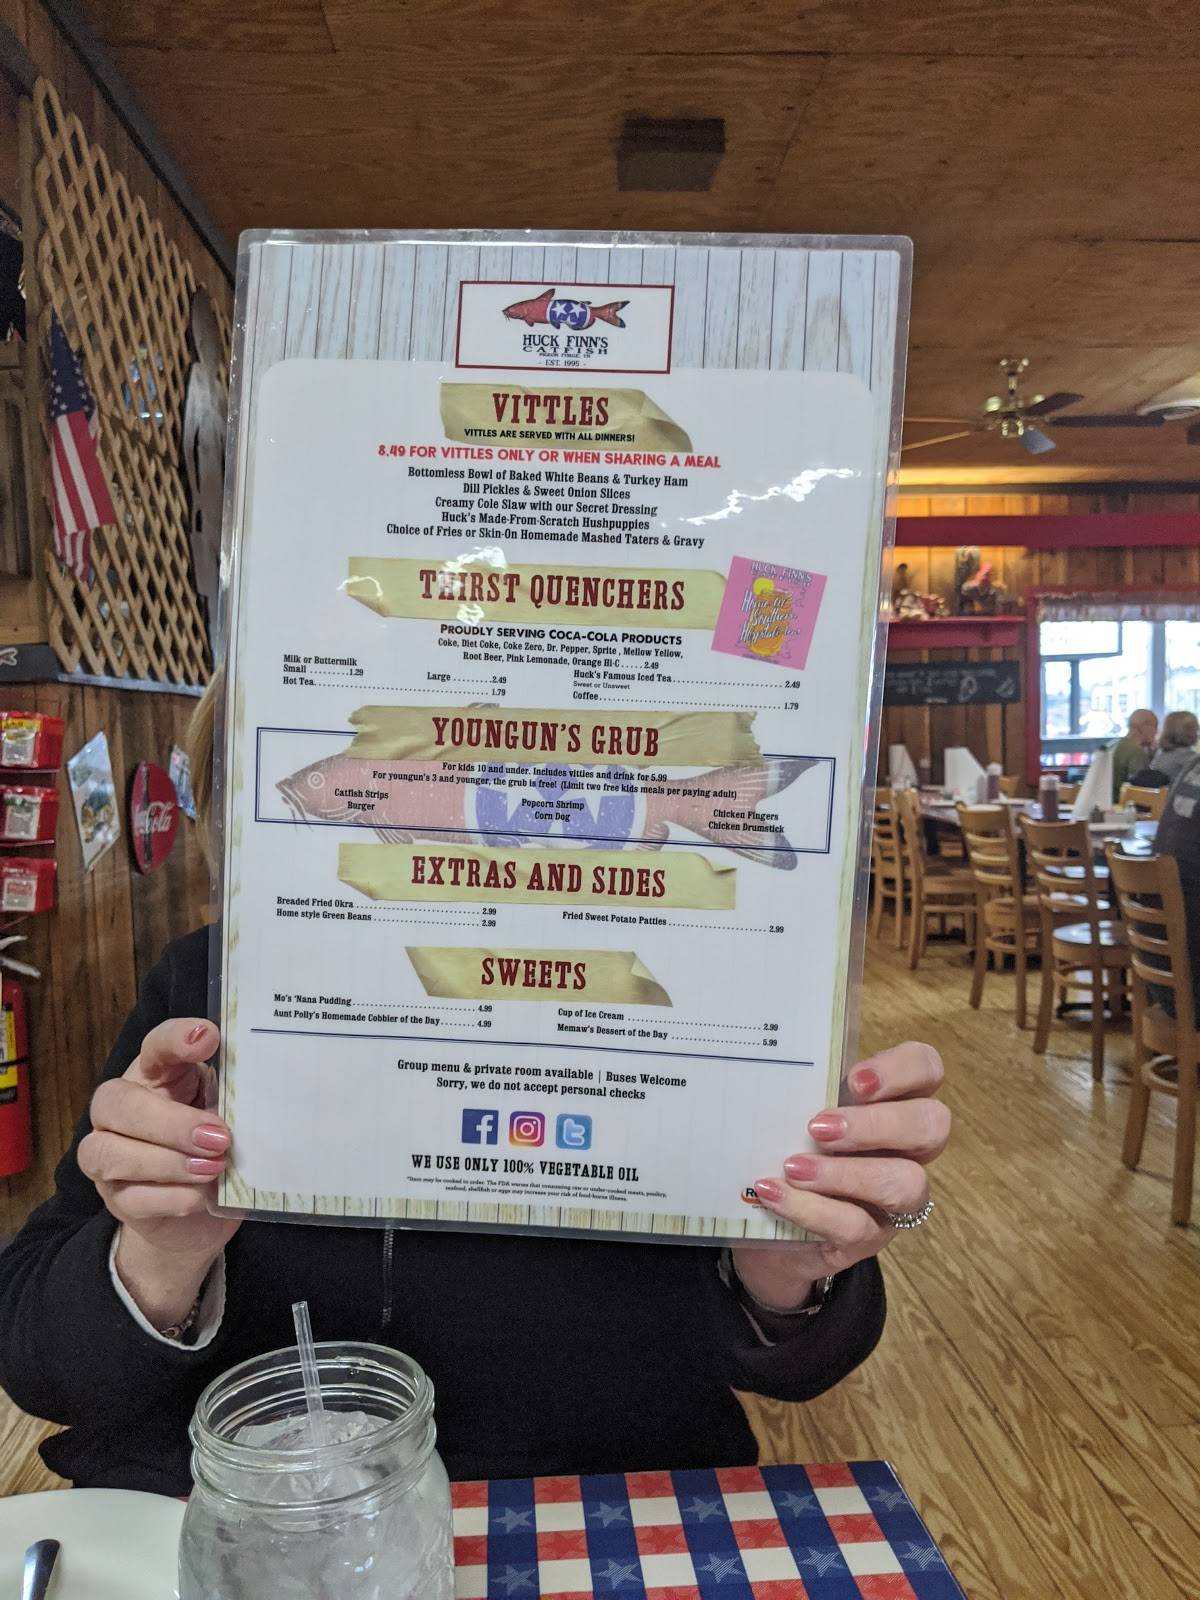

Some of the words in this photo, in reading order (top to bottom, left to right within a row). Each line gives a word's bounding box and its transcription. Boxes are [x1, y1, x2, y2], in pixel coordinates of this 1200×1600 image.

[523, 335, 559, 347] HUCK
[567, 336, 609, 348] FINN'S
[492, 393, 608, 425] VITTLES
[463, 428, 497, 437] VITTLES
[499, 430, 516, 438] ARE
[518, 430, 552, 439] SERVED
[554, 431, 575, 440] WITH
[577, 432, 592, 440] ALL
[594, 433, 634, 441] DINNERS!
[378, 444, 405, 456] 8.49
[409, 445, 436, 457] FOR
[440, 447, 493, 459] VITTLES
[497, 449, 534, 461] ONLY
[538, 450, 559, 462] OR
[563, 451, 600, 463] WHEN
[604, 452, 666, 465] SHARING
[669, 455, 680, 466] A
[684, 455, 720, 467] MEAL
[408, 466, 464, 478] Bottomless
[468, 468, 492, 479] Bowl
[495, 469, 507, 479] of
[509, 470, 541, 481] Baked
[544, 471, 574, 482] White
[577, 472, 609, 483] Beans
[612, 473, 620, 484] &
[623, 474, 660, 487] Turkey
[663, 475, 688, 486] Ham
[463, 482, 479, 493] Dill
[482, 483, 519, 495] Pickles
[522, 485, 531, 495] &
[533, 485, 564, 496] Sweet
[567, 487, 597, 497] Onion
[600, 488, 630, 499] Slices
[435, 496, 474, 509] Creamy
[477, 498, 498, 509] Cole
[501, 498, 527, 509] Slaw
[529, 500, 552, 511] with
[555, 503, 573, 511] our
[576, 502, 608, 513] Secret
[611, 503, 657, 517] Dressing
[441, 511, 475, 522] Huck's
[478, 513, 579, 526] Made-From-Scratch
[582, 517, 649, 530] Hushpuppies
[419, 569, 520, 603] THIRST
[530, 575, 684, 609] QUENCHERS
[440, 624, 493, 635] PROUDLY
[496, 627, 545, 638] SERVING
[548, 629, 618, 642] COCA-COLA
[621, 633, 681, 645] PRODUCTS
[283, 654, 301, 663] Milk
[314, 656, 357, 665] Buttermilk
[283, 663, 306, 673] Small
[350, 668, 363, 676] 1.29
[427, 671, 451, 682] Large
[492, 675, 506, 683] 2.49
[573, 669, 600, 679] Huck's
[603, 671, 635, 680] Famous
[637, 672, 654, 681] Iced
[656, 673, 671, 682] Tea
[784, 680, 800, 688] 2.49
[283, 676, 297, 684] Hot
[298, 677, 315, 685] Tea
[491, 688, 505, 696] 1.79
[572, 690, 598, 700] Coffee
[784, 702, 798, 710] 1.79
[432, 717, 580, 751] YOUNGUN'S
[591, 726, 659, 756] GRUB
[334, 788, 363, 797] Catfish
[364, 789, 389, 800] Strips
[347, 801, 375, 811] Burger
[521, 798, 553, 808] Popcorn
[555, 800, 584, 810] Shrimp
[534, 811, 553, 820] Corn
[555, 812, 570, 822] Dog
[713, 809, 745, 818] Chicken
[747, 810, 778, 821] Fingers
[708, 821, 740, 832] Chicken
[742, 822, 784, 833] Drumstick
[411, 856, 516, 888] EXTRAS
[526, 863, 581, 892] AND
[592, 866, 665, 897] SIDES
[277, 897, 310, 907] Breaded
[312, 898, 332, 908] Fried
[334, 899, 353, 908] Okra
[482, 907, 496, 915] 2.99
[277, 909, 298, 919] Home
[301, 911, 320, 921] style
[322, 910, 345, 919] Green
[347, 912, 371, 920] Beans
[481, 919, 496, 927] 2.99
[562, 912, 583, 920] Fried
[585, 913, 609, 922] Sweet
[610, 914, 636, 923] Potato
[638, 916, 666, 925] Patties
[769, 925, 784, 933] 2.99
[481, 958, 586, 989] SWEETS
[273, 993, 291, 1002] Mo's
[318, 996, 352, 1006] Pudding
[477, 1004, 492, 1012] 4.99
[273, 1009, 292, 1017] Aunt
[293, 1010, 319, 1020] Polly's
[321, 1011, 365, 1021] Homemade
[368, 1013, 398, 1022] Cobbler
[400, 1015, 408, 1023] of
[410, 1015, 422, 1023] the
[425, 1016, 440, 1026] Day
[558, 1008, 572, 1017] Cup
[574, 1009, 583, 1017] of
[584, 1009, 596, 1018] Ice
[598, 1010, 624, 1020] Cream
[763, 1023, 778, 1031] 2.99
[557, 1023, 594, 1033] Memaw's
[596, 1026, 625, 1035] Dessert
[627, 1028, 636, 1036] of
[638, 1029, 650, 1037] the
[652, 1030, 668, 1040] Day
[762, 1038, 777, 1046] 5.99
[397, 1059, 428, 1072] Group
[431, 1063, 459, 1072] menu
[463, 1062, 471, 1073] &
[474, 1064, 511, 1075] private
[514, 1067, 541, 1076] room
[544, 1068, 593, 1079] available
[606, 1071, 636, 1083] Buses
[639, 1073, 686, 1086] Welcome
[436, 1077, 467, 1090] Sorry,
[470, 1081, 485, 1089] we
[488, 1079, 500, 1090] do
[503, 1082, 521, 1090] not
[523, 1083, 558, 1094] accept
[560, 1085, 606, 1096] personal
[609, 1088, 645, 1099] checks
[411, 1154, 431, 1168] WE
[436, 1155, 459, 1169] USE
[464, 1157, 498, 1172] ONLY
[503, 1159, 534, 1173] 100%
[539, 1161, 613, 1179] VEGETABLE
[618, 1167, 638, 1181] OIL
